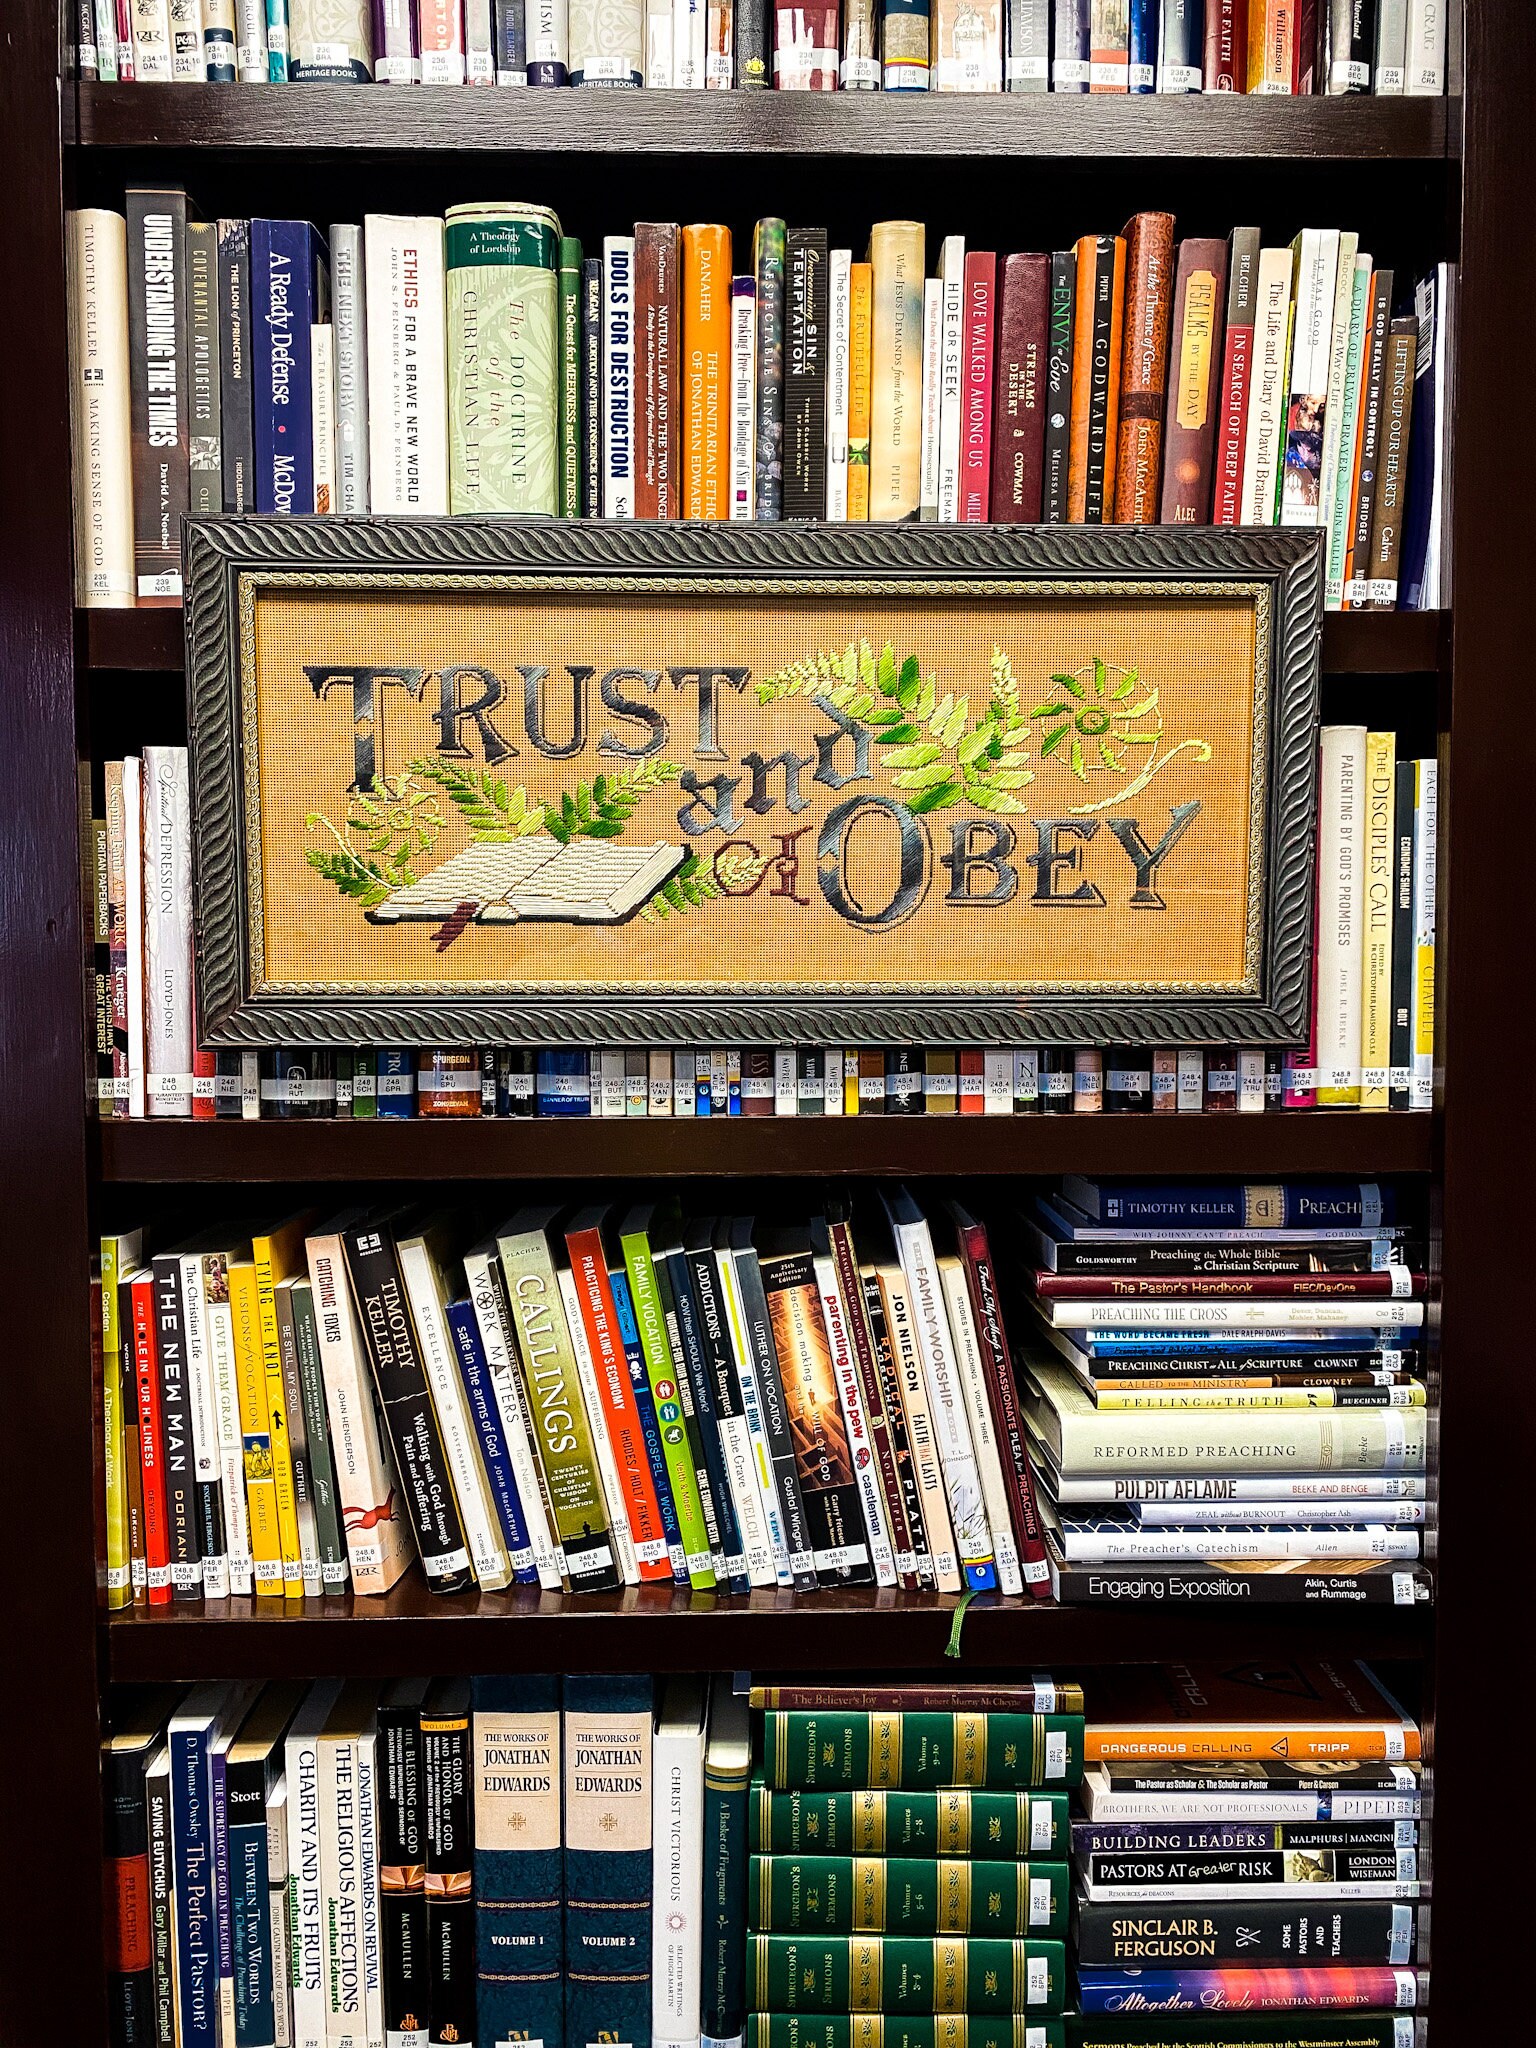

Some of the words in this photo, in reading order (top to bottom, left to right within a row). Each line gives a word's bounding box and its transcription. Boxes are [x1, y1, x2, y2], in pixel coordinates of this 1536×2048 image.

[1275, 10, 1285, 73] Williamson
[1424, 4, 1434, 50] CRAIG
[296, 69, 330, 79] HERITAGE
[331, 69, 358, 79] BOOKS
[84, 225, 95, 295] TIMOTHY
[270, 252, 288, 267] A
[470, 245, 478, 254] of
[482, 244, 520, 255] Lordship
[481, 232, 519, 242] Theology
[143, 214, 176, 357] UNDERSTANDING
[193, 250, 206, 331] COVENANTAL
[231, 264, 239, 280] THE
[403, 249, 418, 308] ETHICS
[610, 250, 629, 305] IDOLS
[700, 250, 711, 322] DANAHER
[837, 272, 846, 292] The
[1238, 255, 1249, 308] BELCHER
[231, 284, 239, 308] LION
[231, 311, 239, 319] of
[270, 271, 290, 330] Ready
[792, 248, 803, 374] TEMPTATION
[836, 295, 846, 332] Secret
[1188, 283, 1210, 338] PSALMS
[86, 299, 97, 357] KELLER
[405, 316, 418, 344] FOR
[509, 300, 524, 341] The
[610, 314, 629, 349] FOR
[836, 336, 845, 346] of
[232, 321, 241, 378] PRINCETON
[271, 334, 290, 405] Defense
[406, 349, 418, 358] A
[463, 291, 479, 428] CHRISTIAN
[147, 360, 176, 391] THE
[194, 336, 210, 419] APOLOGETICS
[407, 364, 418, 409] BRAVE
[836, 349, 845, 416] Contentment
[1025, 343, 1036, 408] STREAMS
[89, 399, 100, 457] MAKING
[148, 394, 178, 447] TIMES
[407, 416, 418, 450] NEW
[510, 356, 526, 485] DOCTRINE
[610, 353, 629, 479] DESTRUCTION
[91, 460, 101, 507] SENSE
[160, 464, 169, 496] David
[407, 453, 418, 503] WORLD
[465, 439, 480, 494] LIFE
[1013, 453, 1023, 504] COWMAN
[93, 513, 102, 529] OF
[161, 501, 169, 511] A.
[1358, 496, 1369, 542] BRIDGES
[93, 538, 103, 565] GOD
[161, 514, 170, 550] Noebel
[1380, 527, 1393, 562] Calvin
[303, 665, 749, 795] TRUST
[677, 695, 872, 837] and
[1377, 749, 1387, 773] THE
[1341, 755, 1354, 822] PARENTING
[1340, 827, 1352, 841] BY
[1372, 777, 1390, 876] DISCIPLES'
[96, 831, 106, 879] PURITAN
[160, 824, 174, 914] DEPRESSION
[816, 801, 1203, 932] OBEY
[1339, 846, 1352, 881] GOD'S
[97, 881, 108, 936] PAPERBACKS
[1338, 887, 1351, 946] PROMISES
[1369, 882, 1386, 932] CALL
[114, 967, 128, 1018] Krueger
[164, 969, 174, 1039] LLOYD-JONES
[1397, 1008, 1407, 1026] BOLT
[432, 1054, 470, 1065] SPURGEON
[1128, 1203, 1185, 1214] TIMOTHY
[1191, 1202, 1235, 1214] KELLER
[506, 1246, 540, 1259] PLACHER
[1076, 1256, 1137, 1264] GOLDSWORTHY
[160, 1273, 177, 1331] THE
[316, 1258, 337, 1308] CATCHING
[631, 1255, 651, 1302] FAMILY
[695, 1263, 721, 1340] ADDICTIONS
[1112, 1282, 1134, 1293] The
[1138, 1281, 1189, 1293] Pastor's
[1192, 1281, 1253, 1293] Handbook
[324, 1313, 341, 1342] FOXES
[364, 1295, 393, 1368] KELLER
[380, 1279, 415, 1369] TIMOTHY
[824, 1295, 851, 1367] parenting
[892, 1295, 905, 1324] JON
[1091, 1308, 1160, 1320] PREACHING
[1165, 1308, 1187, 1320] THE
[1190, 1308, 1228, 1320] CROSS
[640, 1305, 665, 1365] VOCATION
[163, 1343, 181, 1401] NEW
[516, 1275, 577, 1453] CALLINGS
[897, 1329, 920, 1392] NIELSON
[337, 1388, 348, 1413] JOHN
[167, 1414, 185, 1471] MAN
[340, 1417, 355, 1475] HENDERSON
[1093, 1446, 1189, 1458] REFORMED
[1195, 1446, 1297, 1457] PREACHING
[256, 1488, 267, 1533] GARBER
[861, 1474, 881, 1536] castleman
[1115, 1480, 1169, 1499] PULPIT
[1173, 1480, 1237, 1499] AFLAME
[174, 1490, 187, 1564] DORIANI
[1089, 1578, 1164, 1598] Engaging
[1170, 1577, 1250, 1598] Exposition
[1305, 1579, 1327, 1588] Akin,
[1330, 1579, 1357, 1588] Curtis
[1306, 1590, 1319, 1598] and
[1321, 1590, 1366, 1600] Rummage
[484, 1749, 550, 1767] JONATHAN
[485, 1734, 501, 1742] THE
[503, 1734, 534, 1742] WORKS
[536, 1733, 549, 1742] OF
[806, 1721, 817, 1783] SPURGEON'S
[842, 1728, 852, 1778] SERMONS
[1101, 1744, 1186, 1754] DANGEROUS
[1193, 1744, 1252, 1753] CALLING
[1309, 1744, 1349, 1752] TRIPP
[231, 1791, 260, 1803] Stott
[299, 1750, 317, 1833] CHARITY
[484, 1776, 550, 1792] EDWARDS
[670, 1767, 681, 1815] CHRIST
[151, 1797, 164, 1838] SAVING
[337, 1791, 355, 1893] RELIGIOUS
[670, 1819, 681, 1902] VICTORIOUS
[1092, 1836, 1181, 1850] BUILDING
[1187, 1834, 1266, 1848] LEADERS
[1349, 1856, 1394, 1865] LONDON
[153, 1842, 166, 1899] EUTYCHUS
[1101, 1865, 1164, 1878] PASTORS
[1168, 1864, 1187, 1877] AT
[1188, 1862, 1237, 1877] Greater
[1238, 1862, 1272, 1876] RISK
[1349, 1869, 1395, 1878] WISEMAN
[401, 1913, 411, 1979] McMULLEN
[491, 1936, 535, 1945] VOLUME
[1112, 1920, 1199, 1937] SINCLAIR
[1203, 1919, 1218, 1935] B.
[1114, 1940, 1215, 1956] FERGUSON
[304, 1919, 321, 1990] FRUITS
[340, 1897, 358, 2013] AFFECTIONS
[1261, 1996, 1316, 2006] JONATHAN
[1319, 1995, 1369, 2005] EDWARDS
